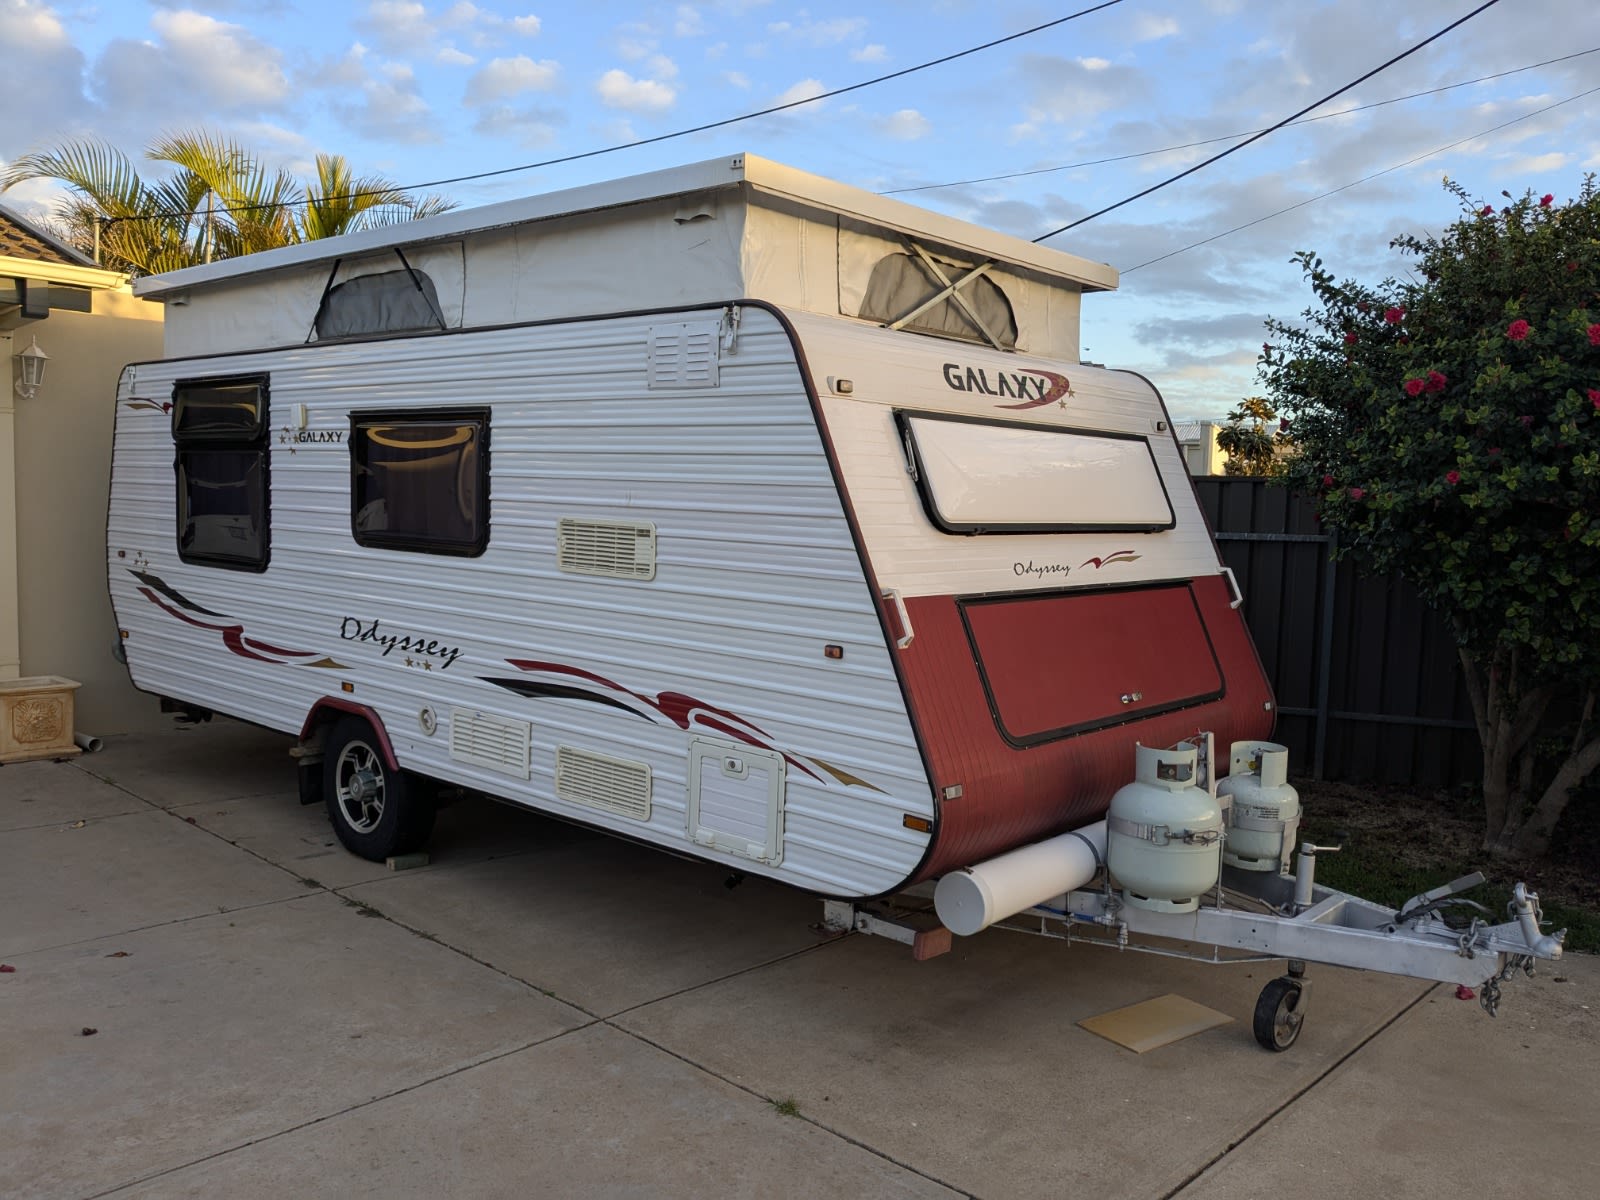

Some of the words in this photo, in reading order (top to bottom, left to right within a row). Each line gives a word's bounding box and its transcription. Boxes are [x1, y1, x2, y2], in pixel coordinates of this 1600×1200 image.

[943, 363, 1047, 402] GALAXY
[299, 431, 343, 443] GALAXY
[1013, 560, 1071, 579] Odyssey
[340, 616, 465, 669] Odyssey
